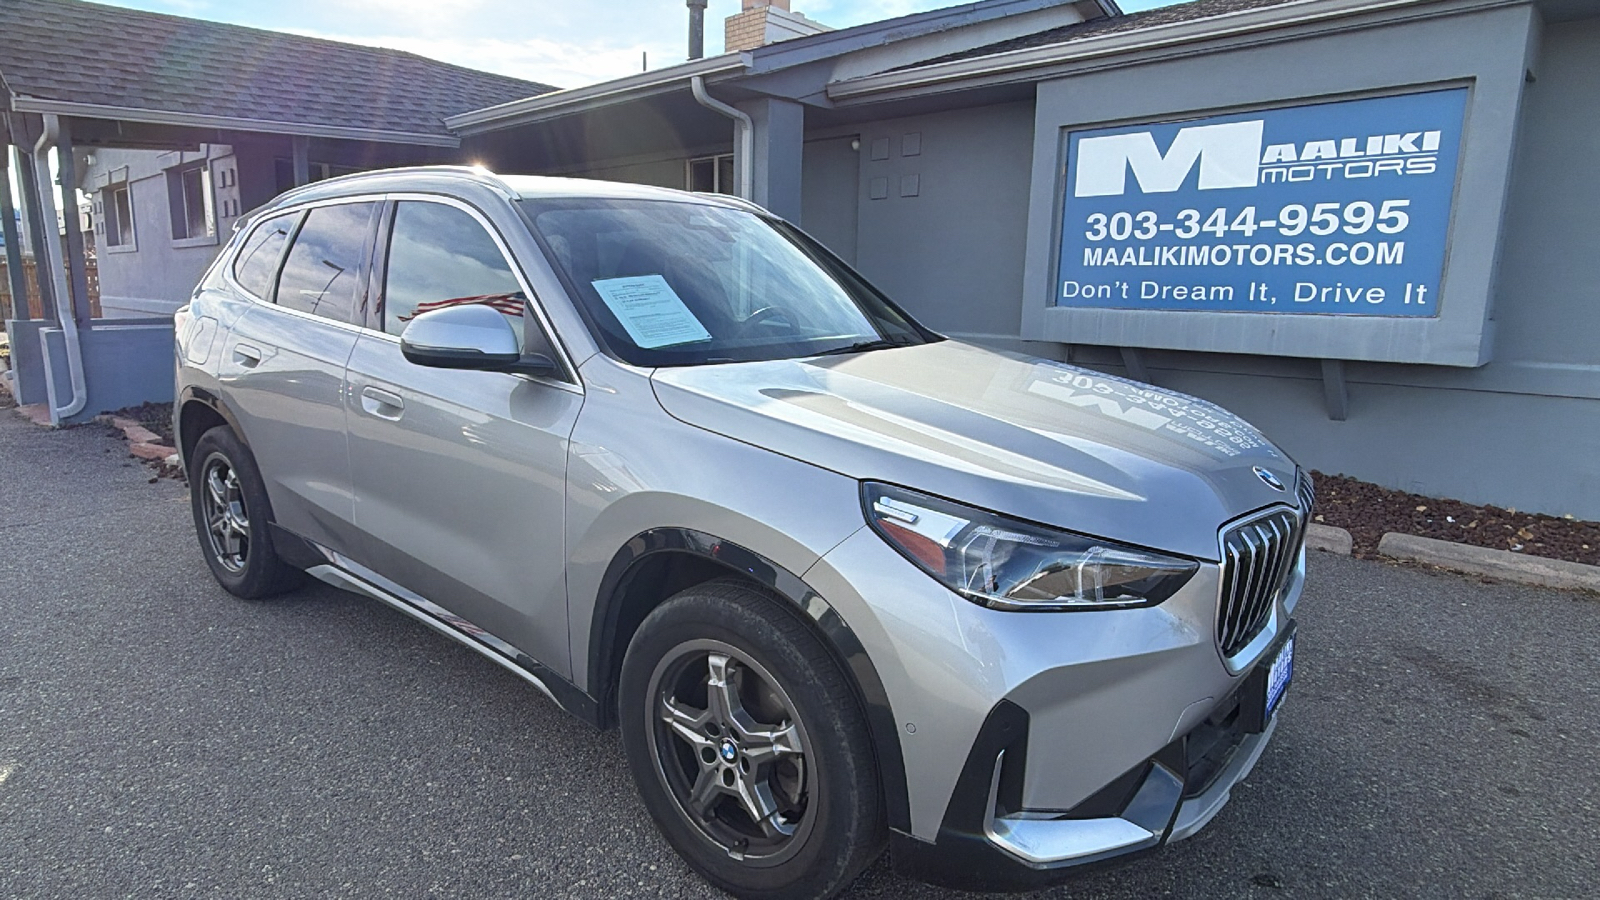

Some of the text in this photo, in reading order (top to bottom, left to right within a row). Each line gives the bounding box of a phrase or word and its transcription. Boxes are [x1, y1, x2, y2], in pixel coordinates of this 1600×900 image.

[1261, 156, 1438, 184] MOTORS
[1084, 199, 1411, 241] 303-344-9595
[1083, 241, 1405, 267] MAALIKIMOTORS.COM
[1140, 281, 1234, 301] Dream
[1249, 282, 1277, 305] It,
[1294, 282, 1386, 304] Drive
[1404, 283, 1428, 305] It
